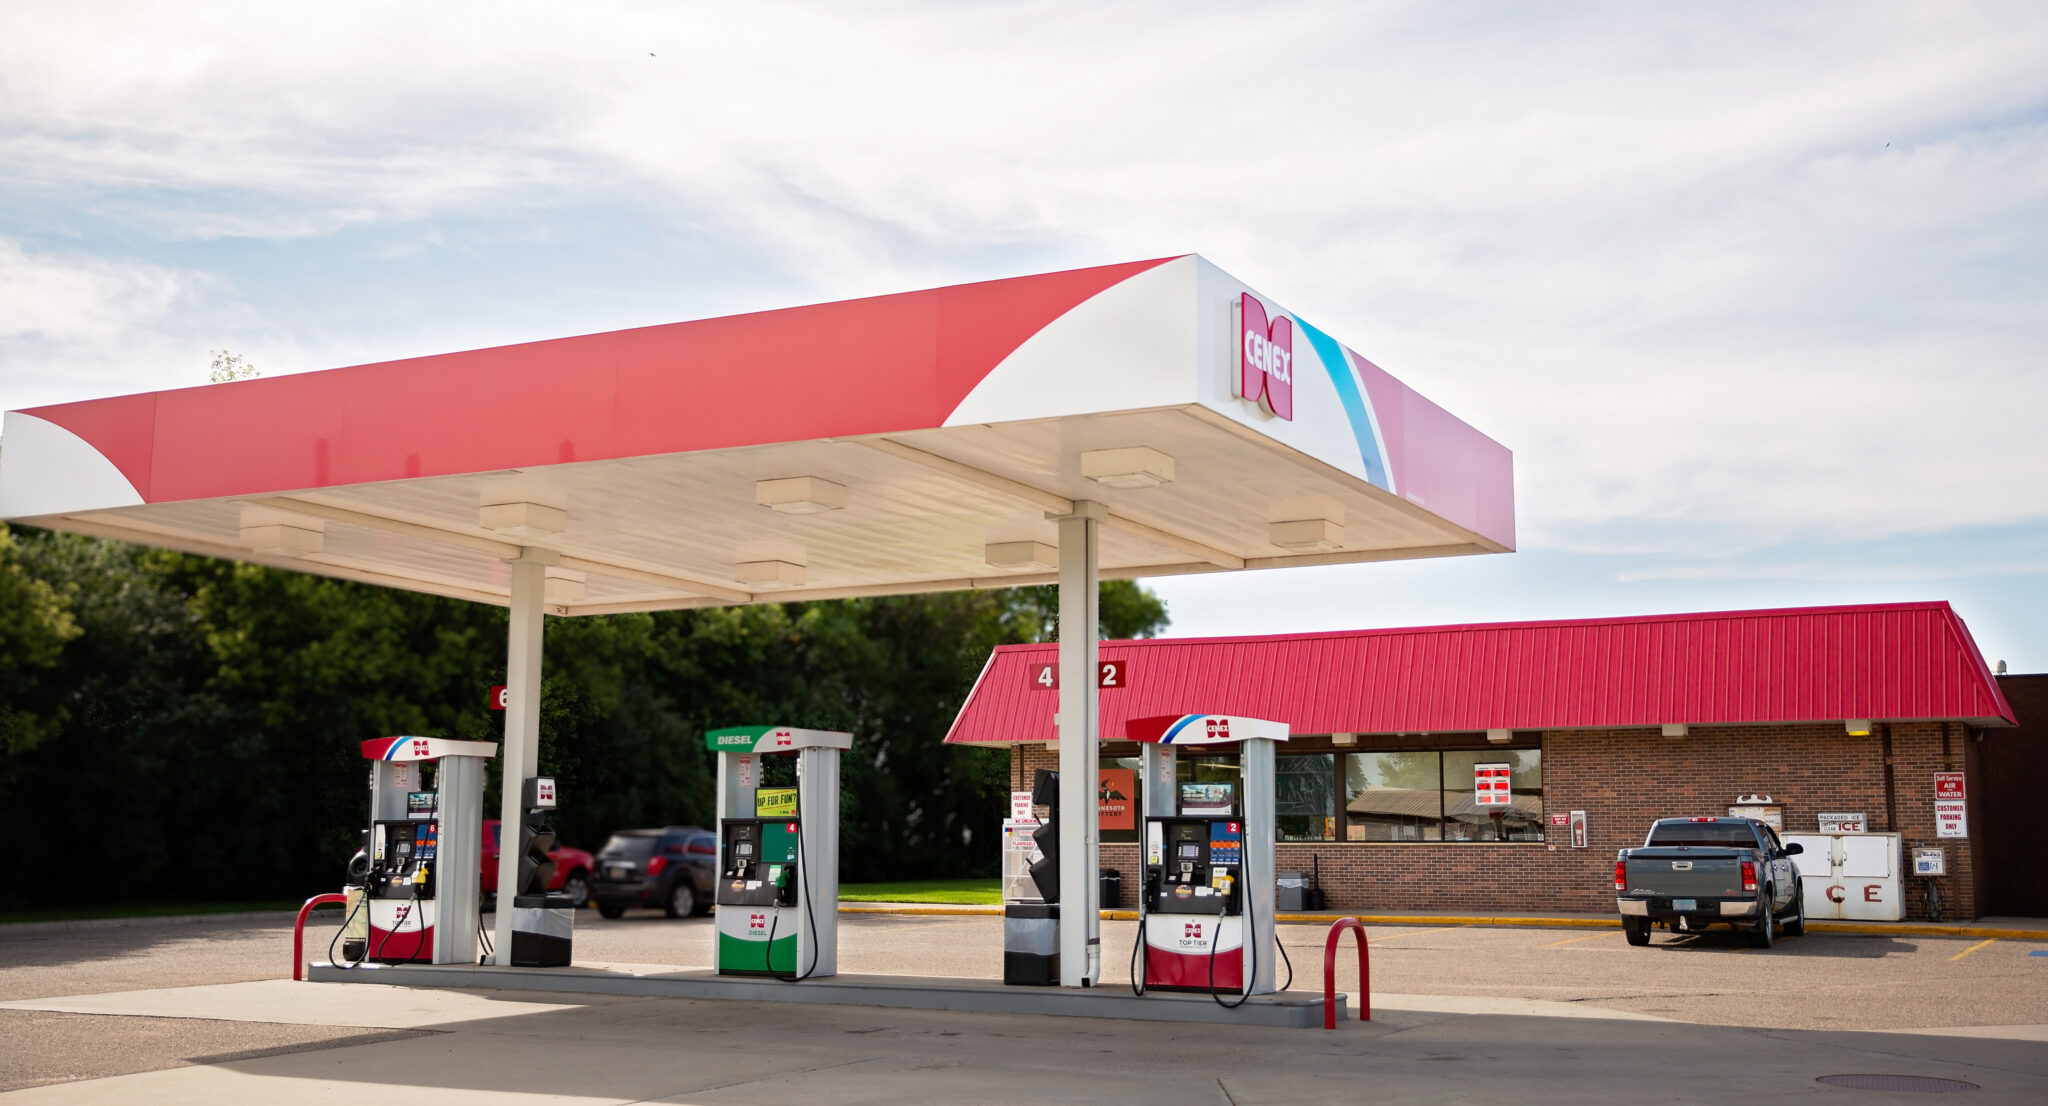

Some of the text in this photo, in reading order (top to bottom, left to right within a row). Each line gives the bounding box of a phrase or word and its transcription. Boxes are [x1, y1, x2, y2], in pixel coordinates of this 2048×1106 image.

[1245, 330, 1291, 386] CENEX
[1038, 666, 1053, 687] 4
[1102, 664, 1117, 686] 2
[718, 735, 752, 745] DIESEL
[757, 797, 766, 808] UP
[767, 795, 779, 806] FOR
[789, 823, 795, 832] 4
[1230, 823, 1237, 832] 2
[1838, 822, 1861, 832] ICE
